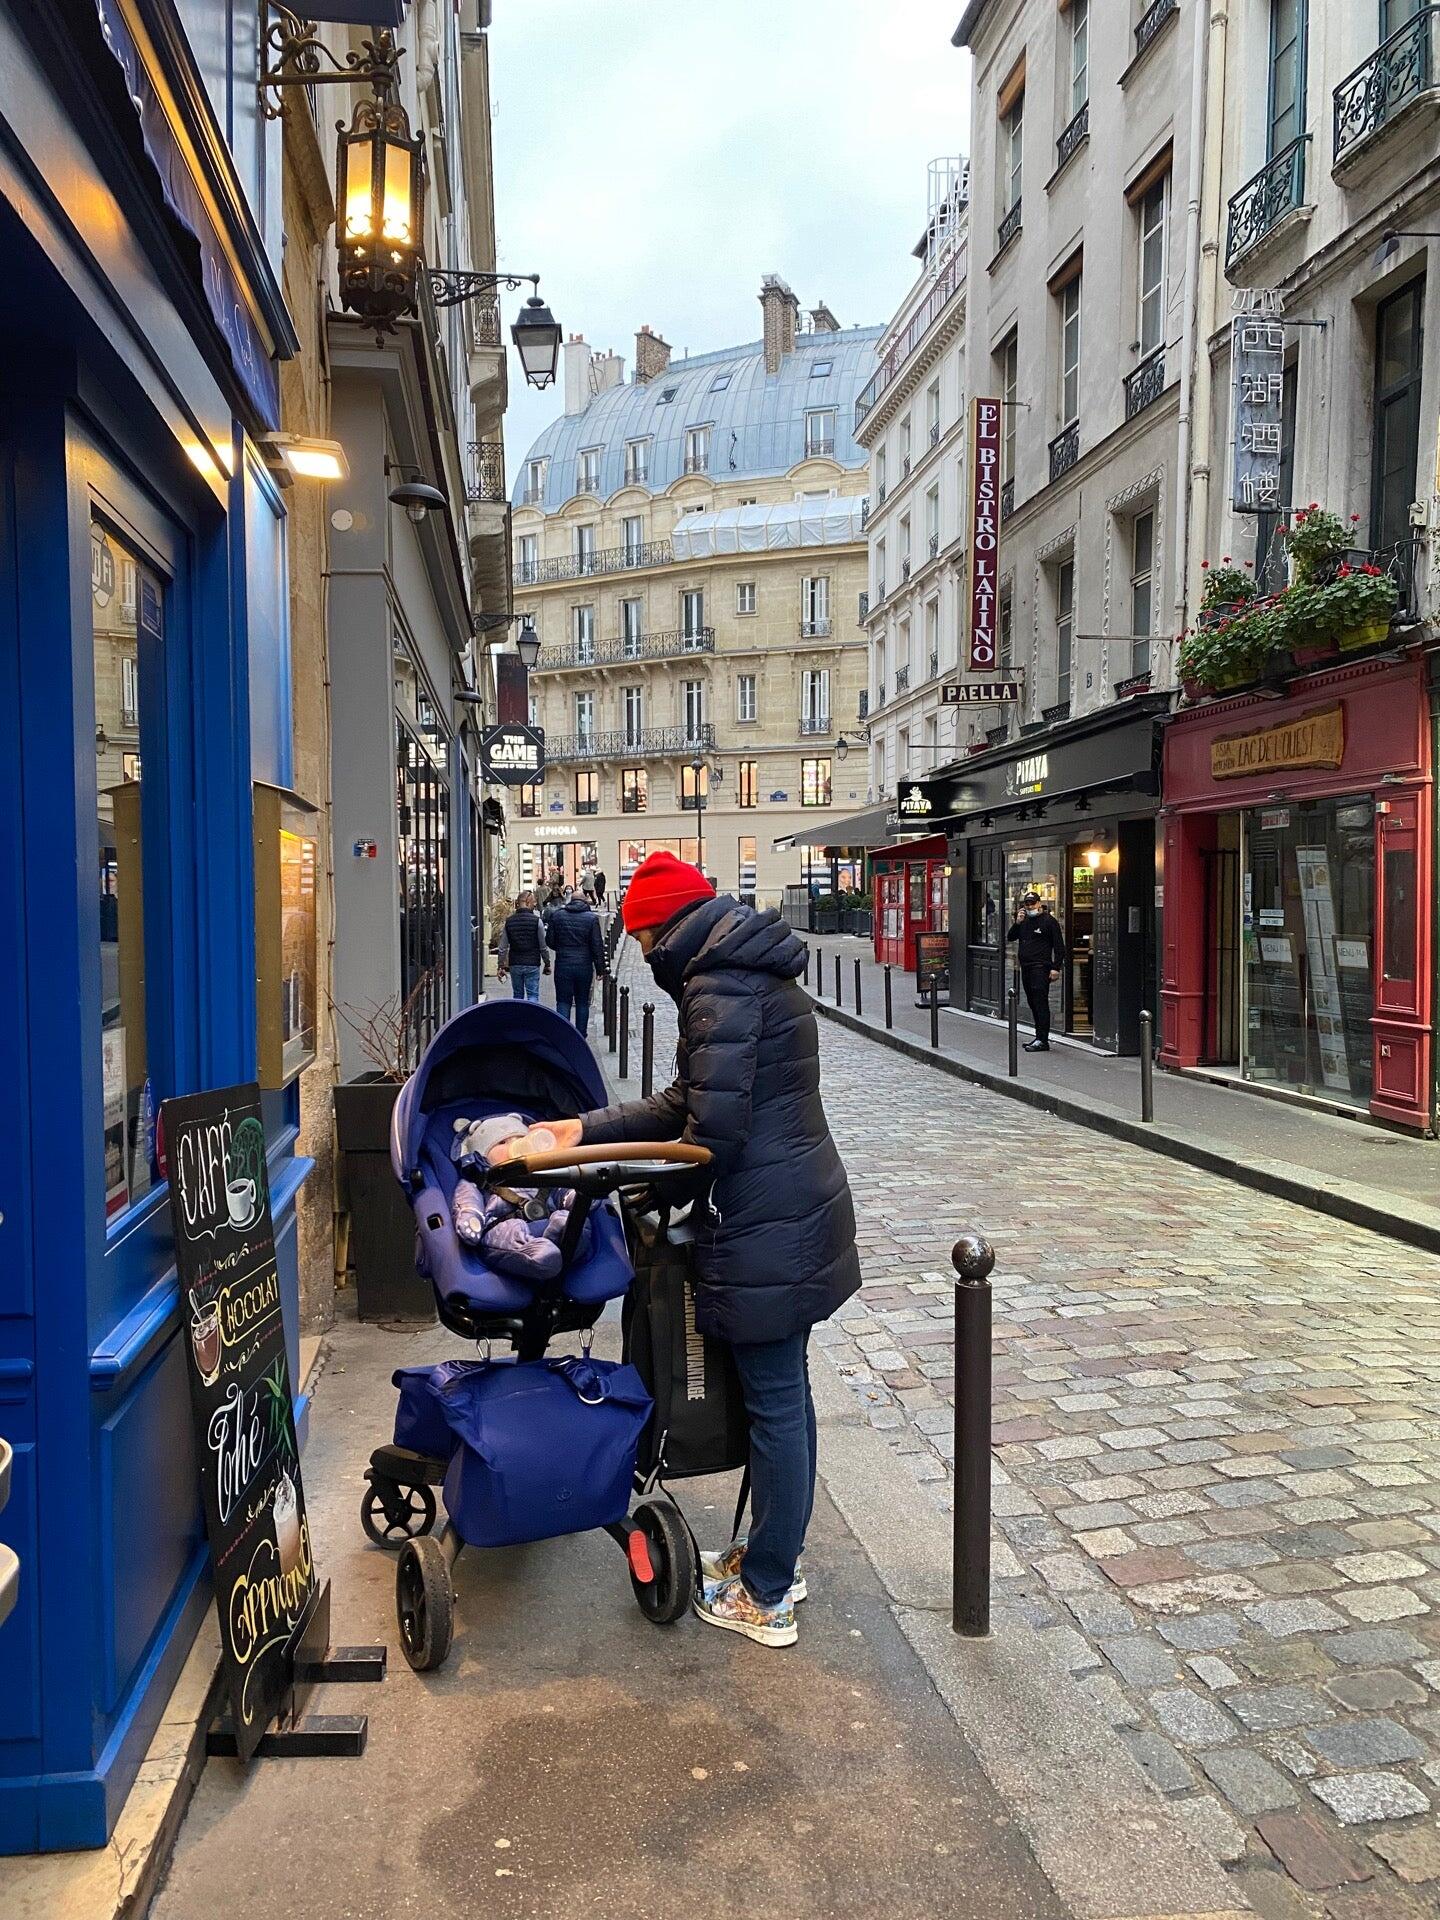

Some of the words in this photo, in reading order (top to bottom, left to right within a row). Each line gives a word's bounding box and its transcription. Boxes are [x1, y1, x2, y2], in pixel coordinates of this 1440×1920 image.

[978, 404, 997, 439] EL
[976, 448, 996, 552] BISTRO
[972, 559, 994, 663] LATINO
[947, 685, 1011, 701] PAELLA
[490, 744, 537, 761] GAME
[502, 735, 525, 744] THE
[1238, 738, 1256, 767] LAC
[1258, 735, 1272, 763] DE
[534, 825, 578, 837] SEPHORA
[179, 1107, 233, 1225] CAFÉ
[218, 1270, 278, 1348] CHOCOLAT
[207, 1382, 265, 1523] Thé
